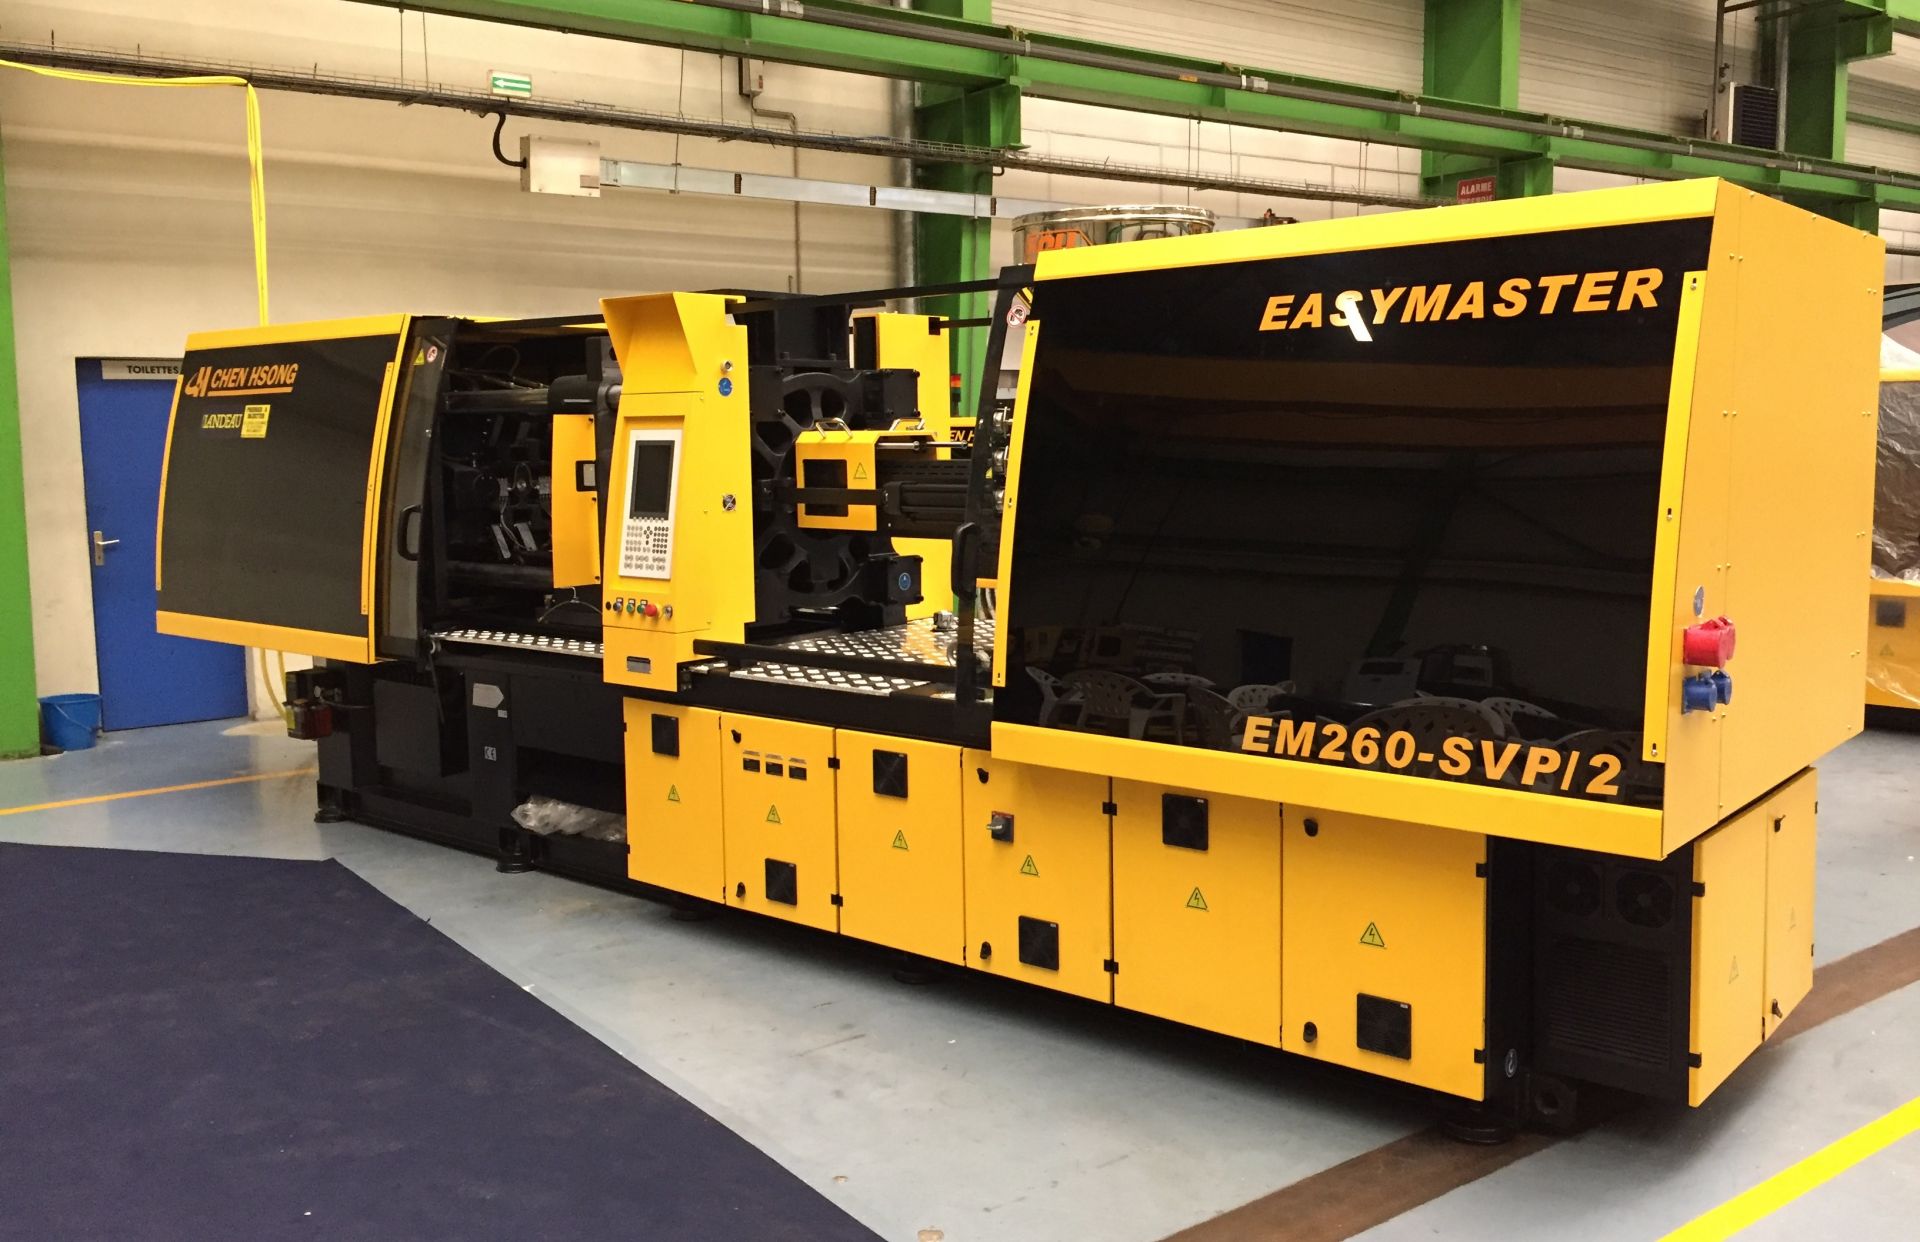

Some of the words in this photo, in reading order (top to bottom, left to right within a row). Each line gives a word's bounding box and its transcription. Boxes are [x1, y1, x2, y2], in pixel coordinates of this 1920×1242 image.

[1258, 267, 1664, 341] EASYMASTER
[127, 365, 179, 374] TOILETTES
[211, 367, 249, 389] CHEN
[250, 363, 299, 387] HSONG
[202, 413, 243, 429] LANDEAU
[1241, 715, 1623, 796] EM260-SVP/2
